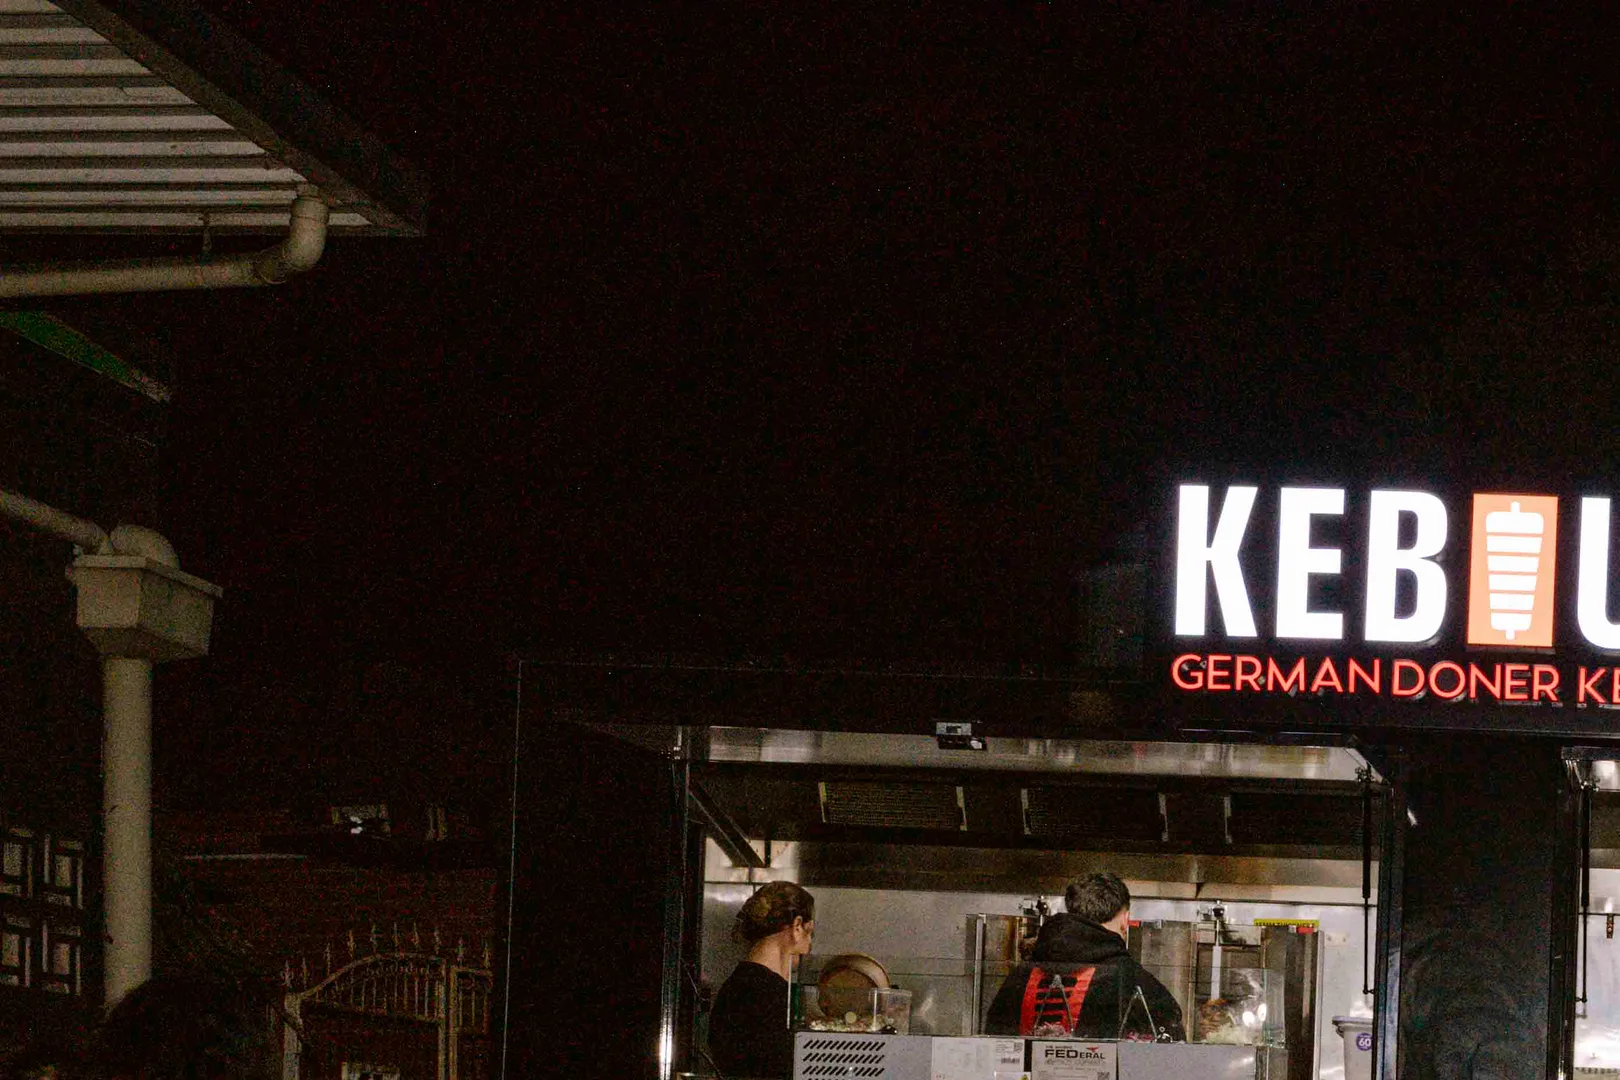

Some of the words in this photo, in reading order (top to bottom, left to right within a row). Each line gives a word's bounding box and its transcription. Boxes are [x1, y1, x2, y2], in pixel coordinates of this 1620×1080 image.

[1174, 484, 1450, 644] KEB
[1171, 652, 1381, 697] GERMAN
[1390, 658, 1559, 701] DONER
